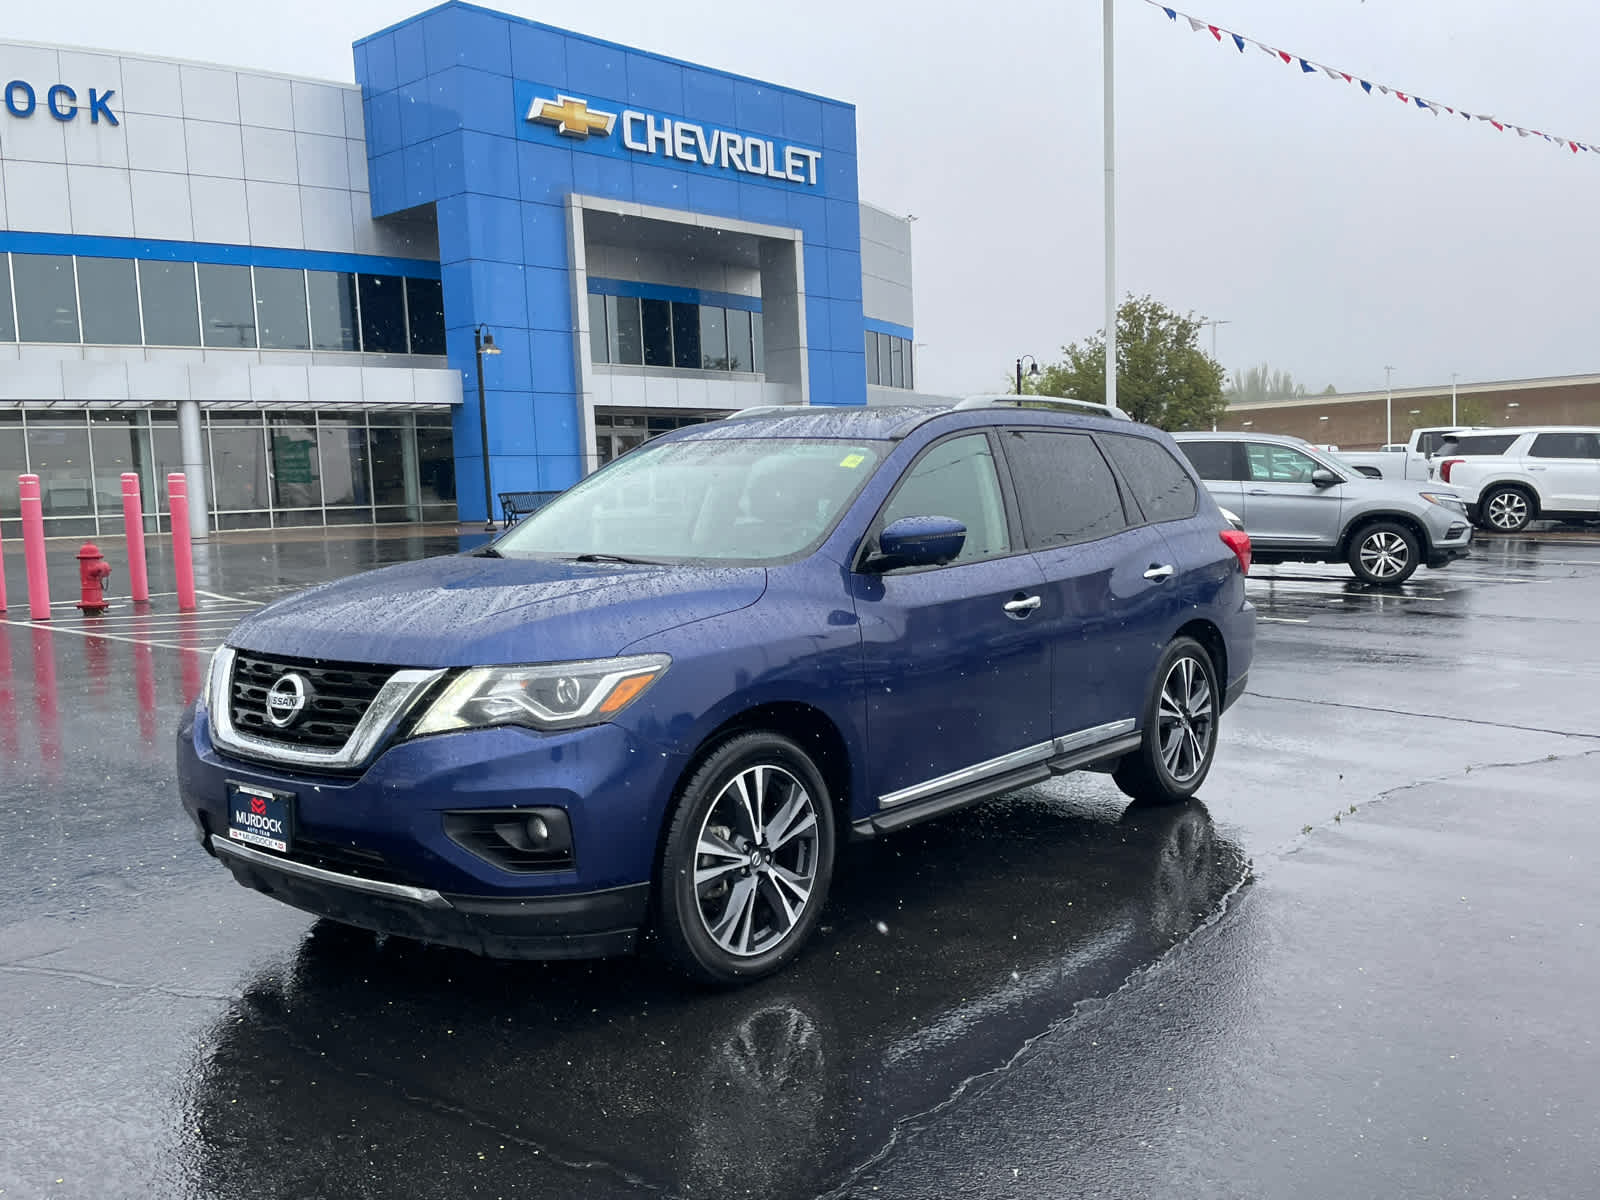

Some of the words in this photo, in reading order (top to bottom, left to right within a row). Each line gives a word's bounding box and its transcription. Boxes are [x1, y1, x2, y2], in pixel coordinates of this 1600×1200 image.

[4, 79, 120, 127] OCK
[621, 109, 822, 185] CHEVROLET
[235, 810, 283, 834] MURDOCK
